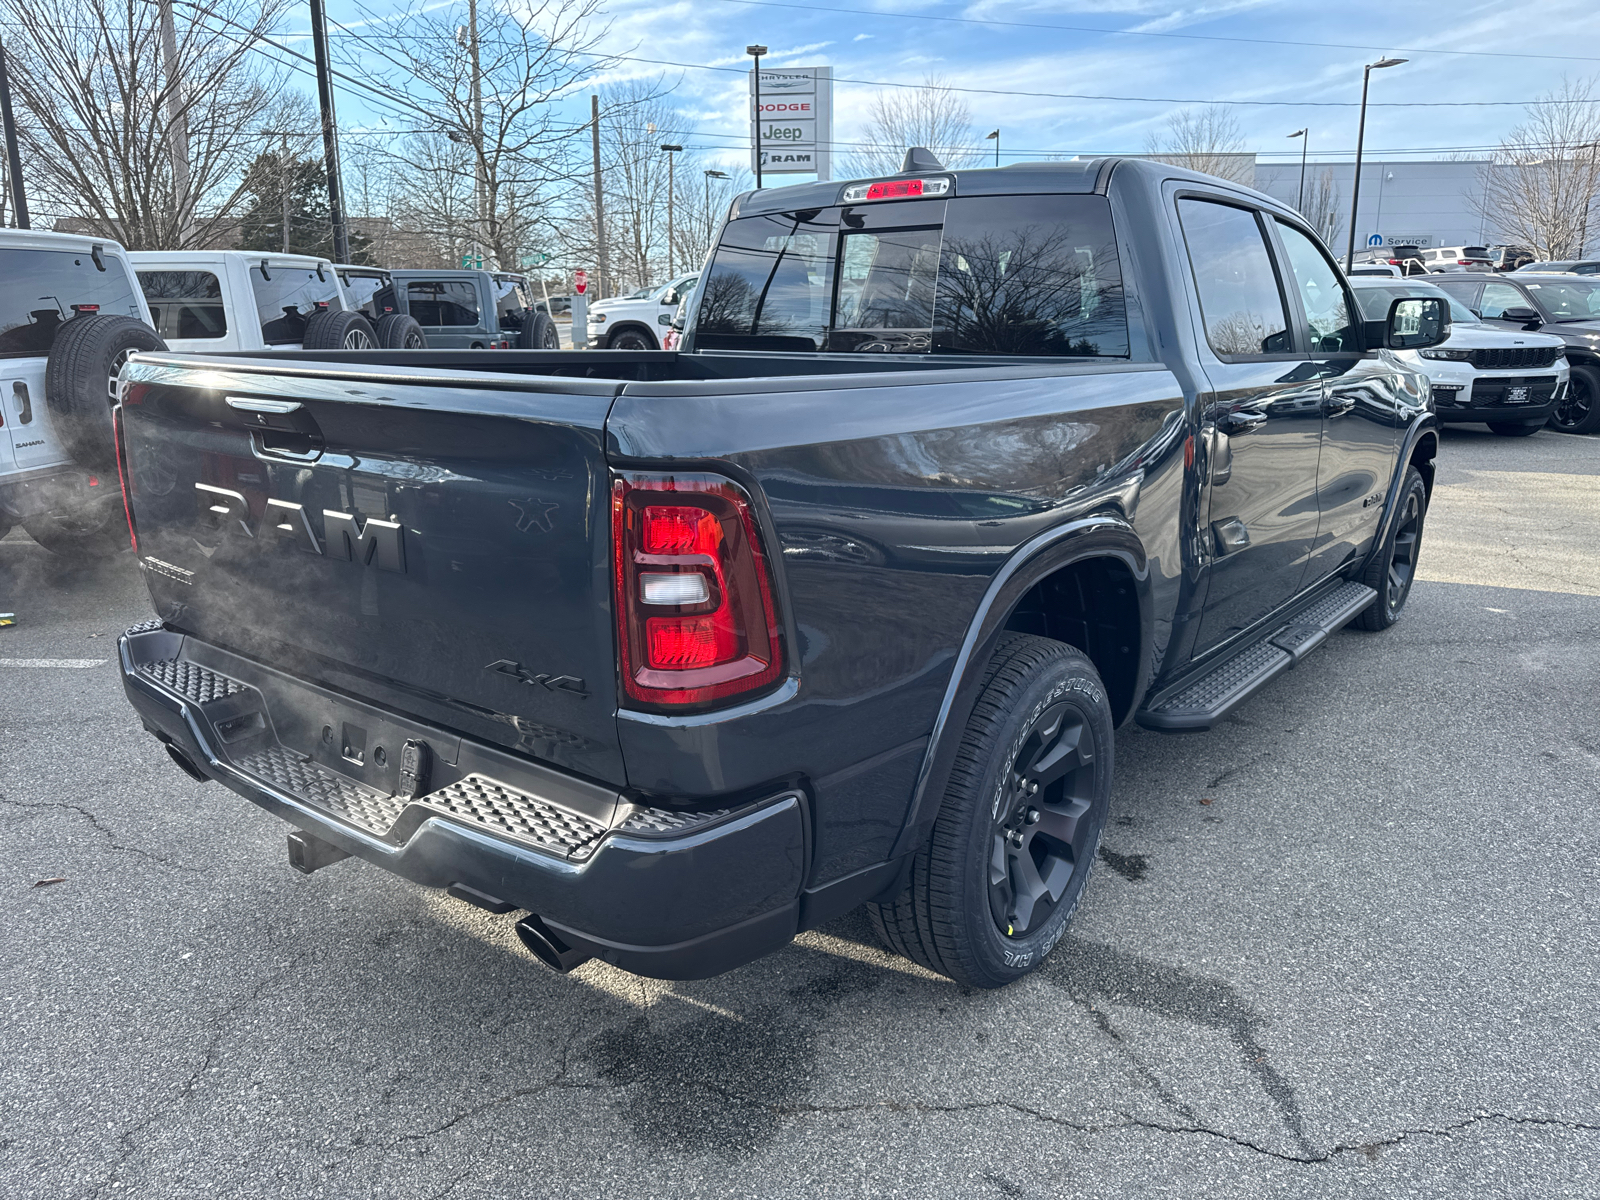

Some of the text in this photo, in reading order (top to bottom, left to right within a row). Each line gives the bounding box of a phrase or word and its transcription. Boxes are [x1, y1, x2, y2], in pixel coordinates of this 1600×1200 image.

[762, 124, 803, 142] Jeep
[771, 154, 811, 163] RAM
[1387, 237, 1428, 246] Service
[15, 439, 46, 449] SAHARA
[194, 482, 407, 574] RAM
